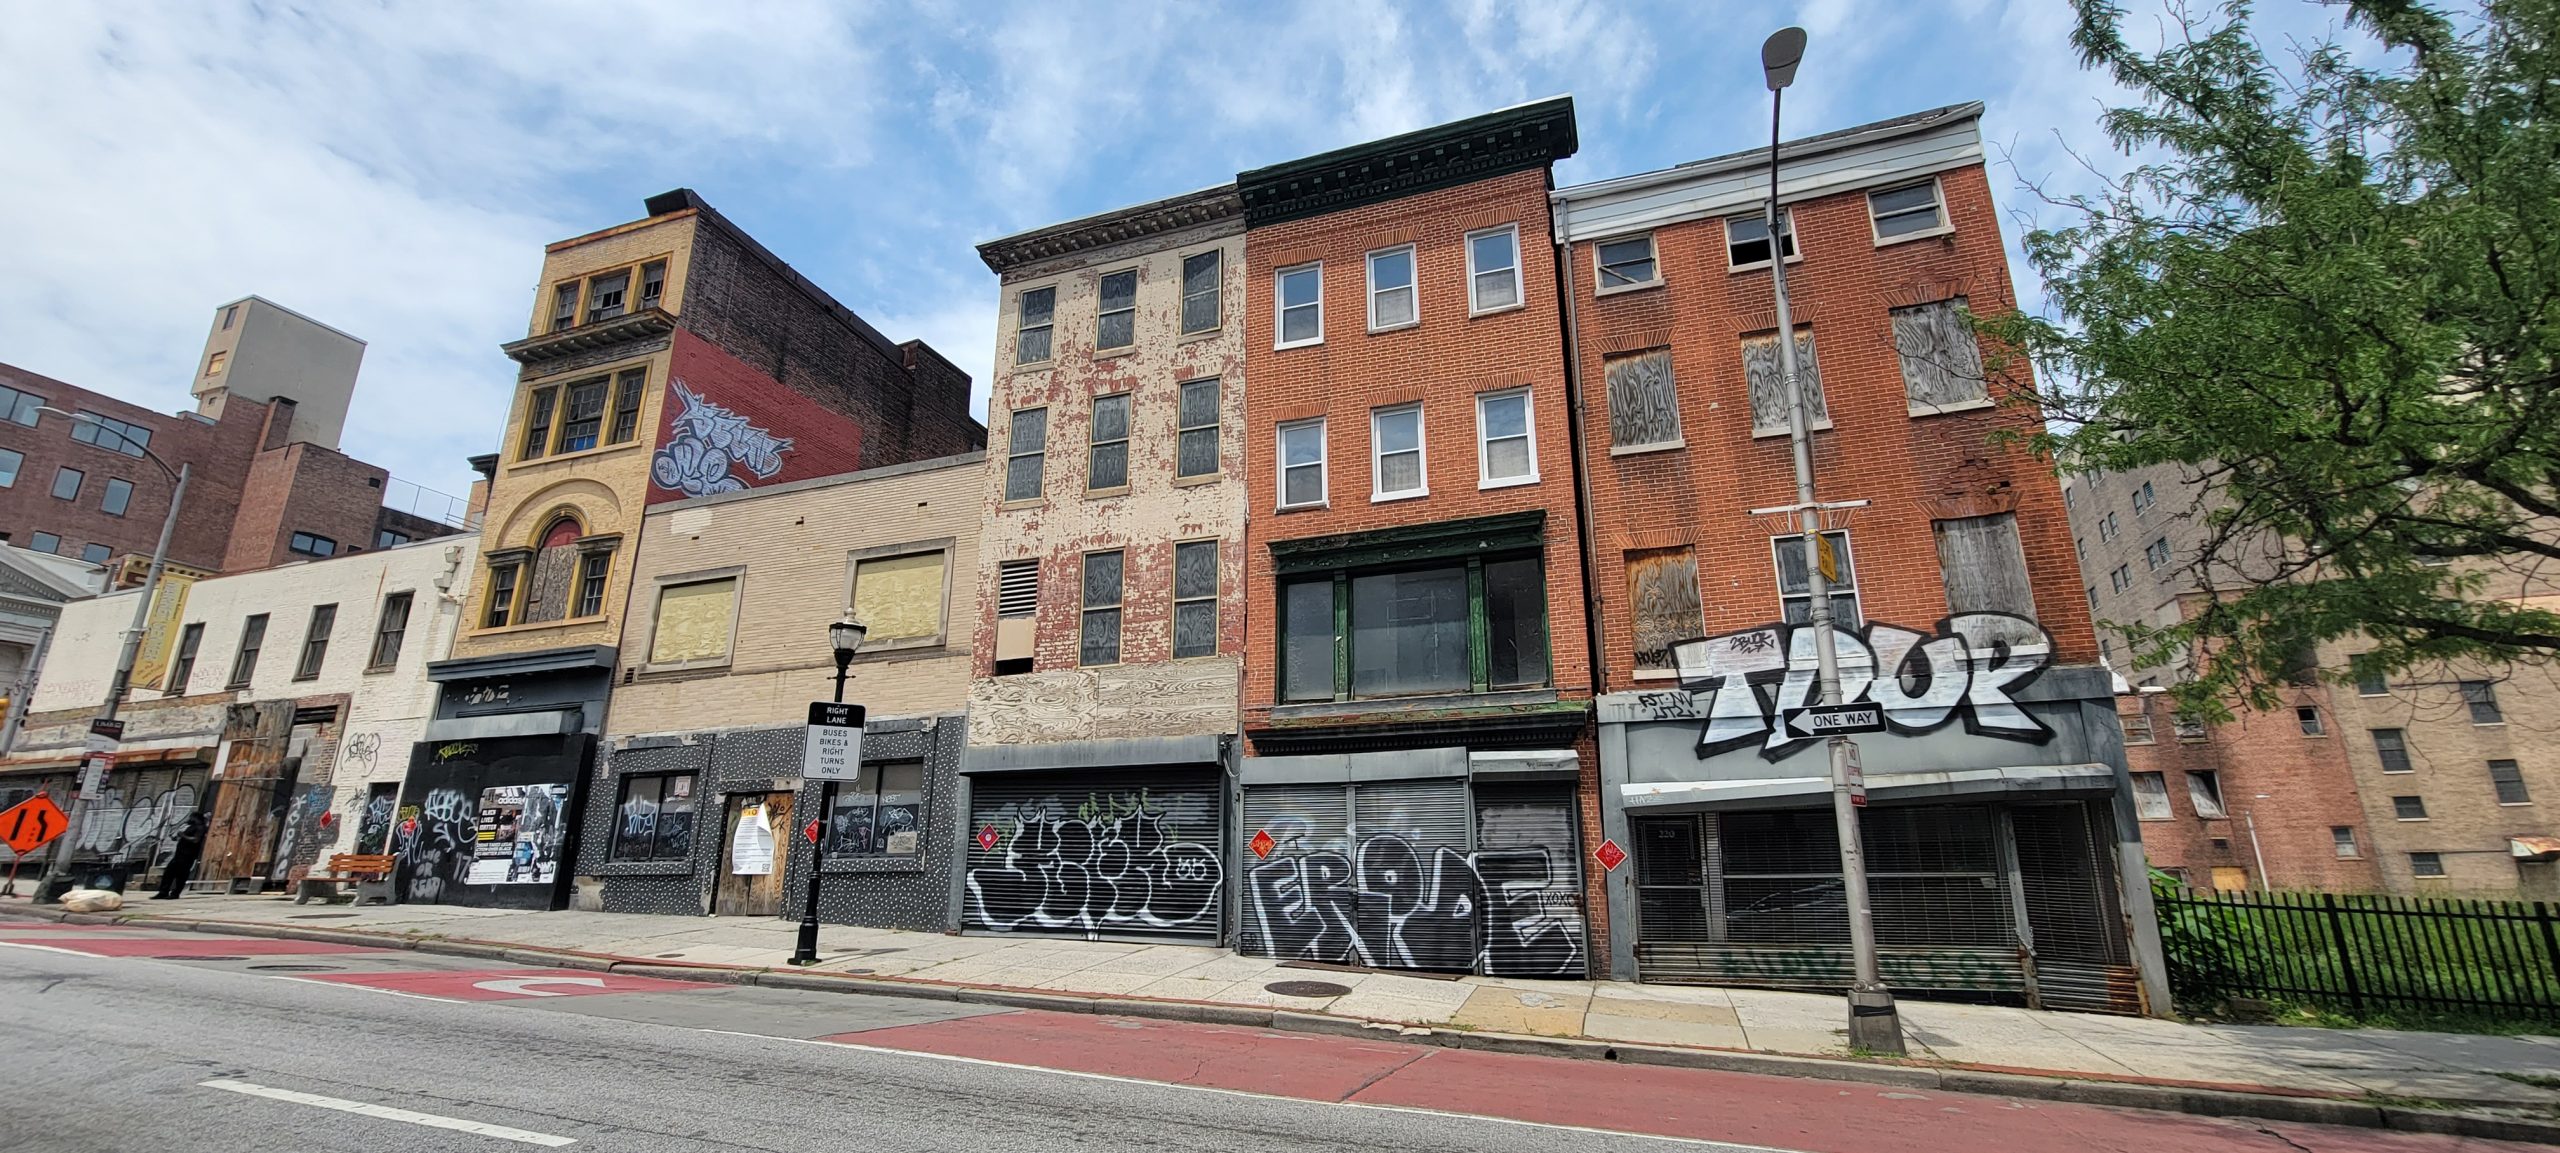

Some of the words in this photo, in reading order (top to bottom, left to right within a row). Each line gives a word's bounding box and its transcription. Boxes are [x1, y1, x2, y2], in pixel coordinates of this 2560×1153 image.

[826, 706, 849, 715] RIGHT
[826, 716, 847, 724] LANE
[1813, 714, 1841, 727] ONE
[1844, 712, 1873, 725] WAY
[823, 729, 848, 737] BUSES
[819, 738, 842, 746] BIKES
[822, 748, 844, 756] RIGHT
[820, 757, 845, 765] TURNS
[821, 766, 841, 774] ONLY
